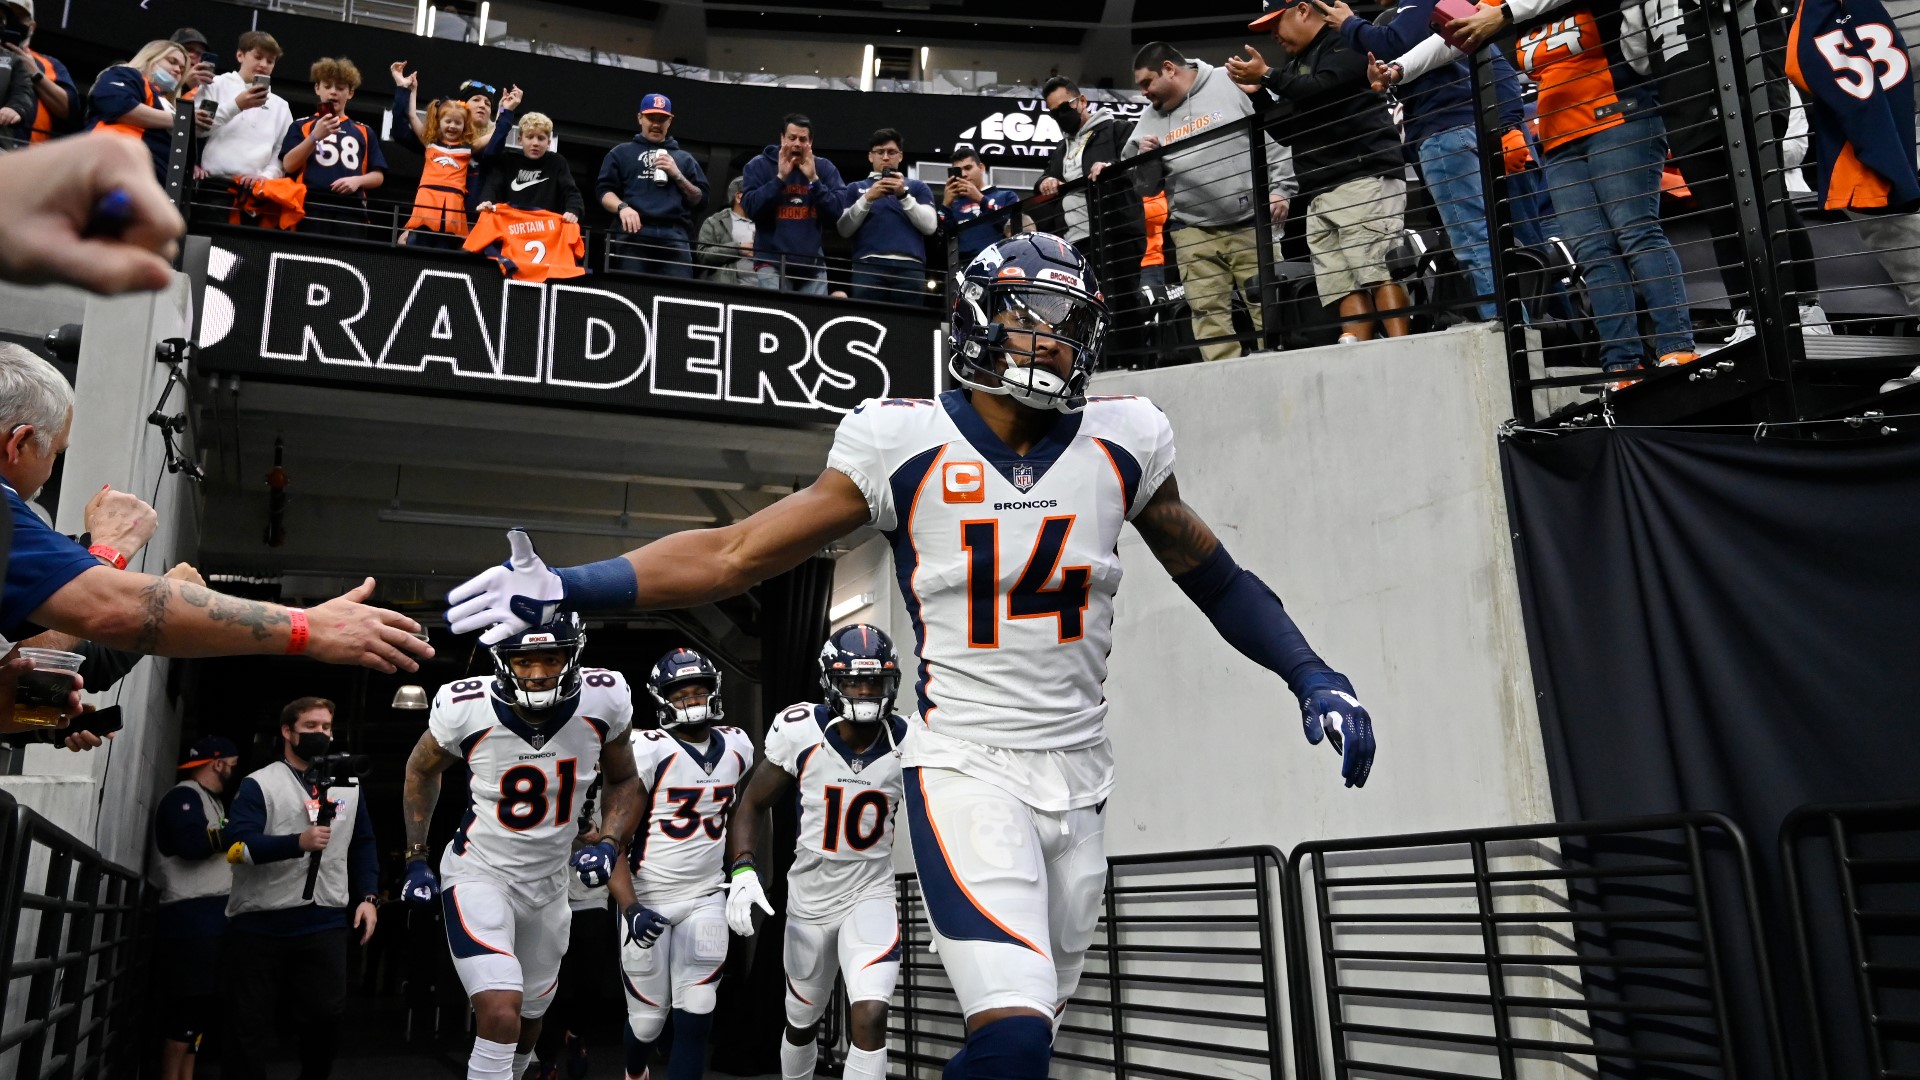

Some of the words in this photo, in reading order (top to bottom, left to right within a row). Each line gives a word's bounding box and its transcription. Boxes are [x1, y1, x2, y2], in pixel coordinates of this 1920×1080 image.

[1813, 22, 1909, 100] 53
[315, 134, 360, 170] 58
[516, 169, 542, 181] NIKE
[508, 220, 545, 235] SURTAIN
[548, 219, 555, 231] II
[524, 240, 547, 265] 2
[1050, 271, 1078, 286] BRONCOS
[261, 252, 890, 413] RAIDERS
[946, 464, 980, 492] C
[994, 500, 1057, 510] BRONCOS
[960, 514, 1092, 648] 14
[450, 680, 485, 704] 81
[519, 752, 556, 760] BRONCOS
[497, 757, 577, 831] 81
[659, 784, 736, 841] 33
[822, 785, 889, 852] 10
